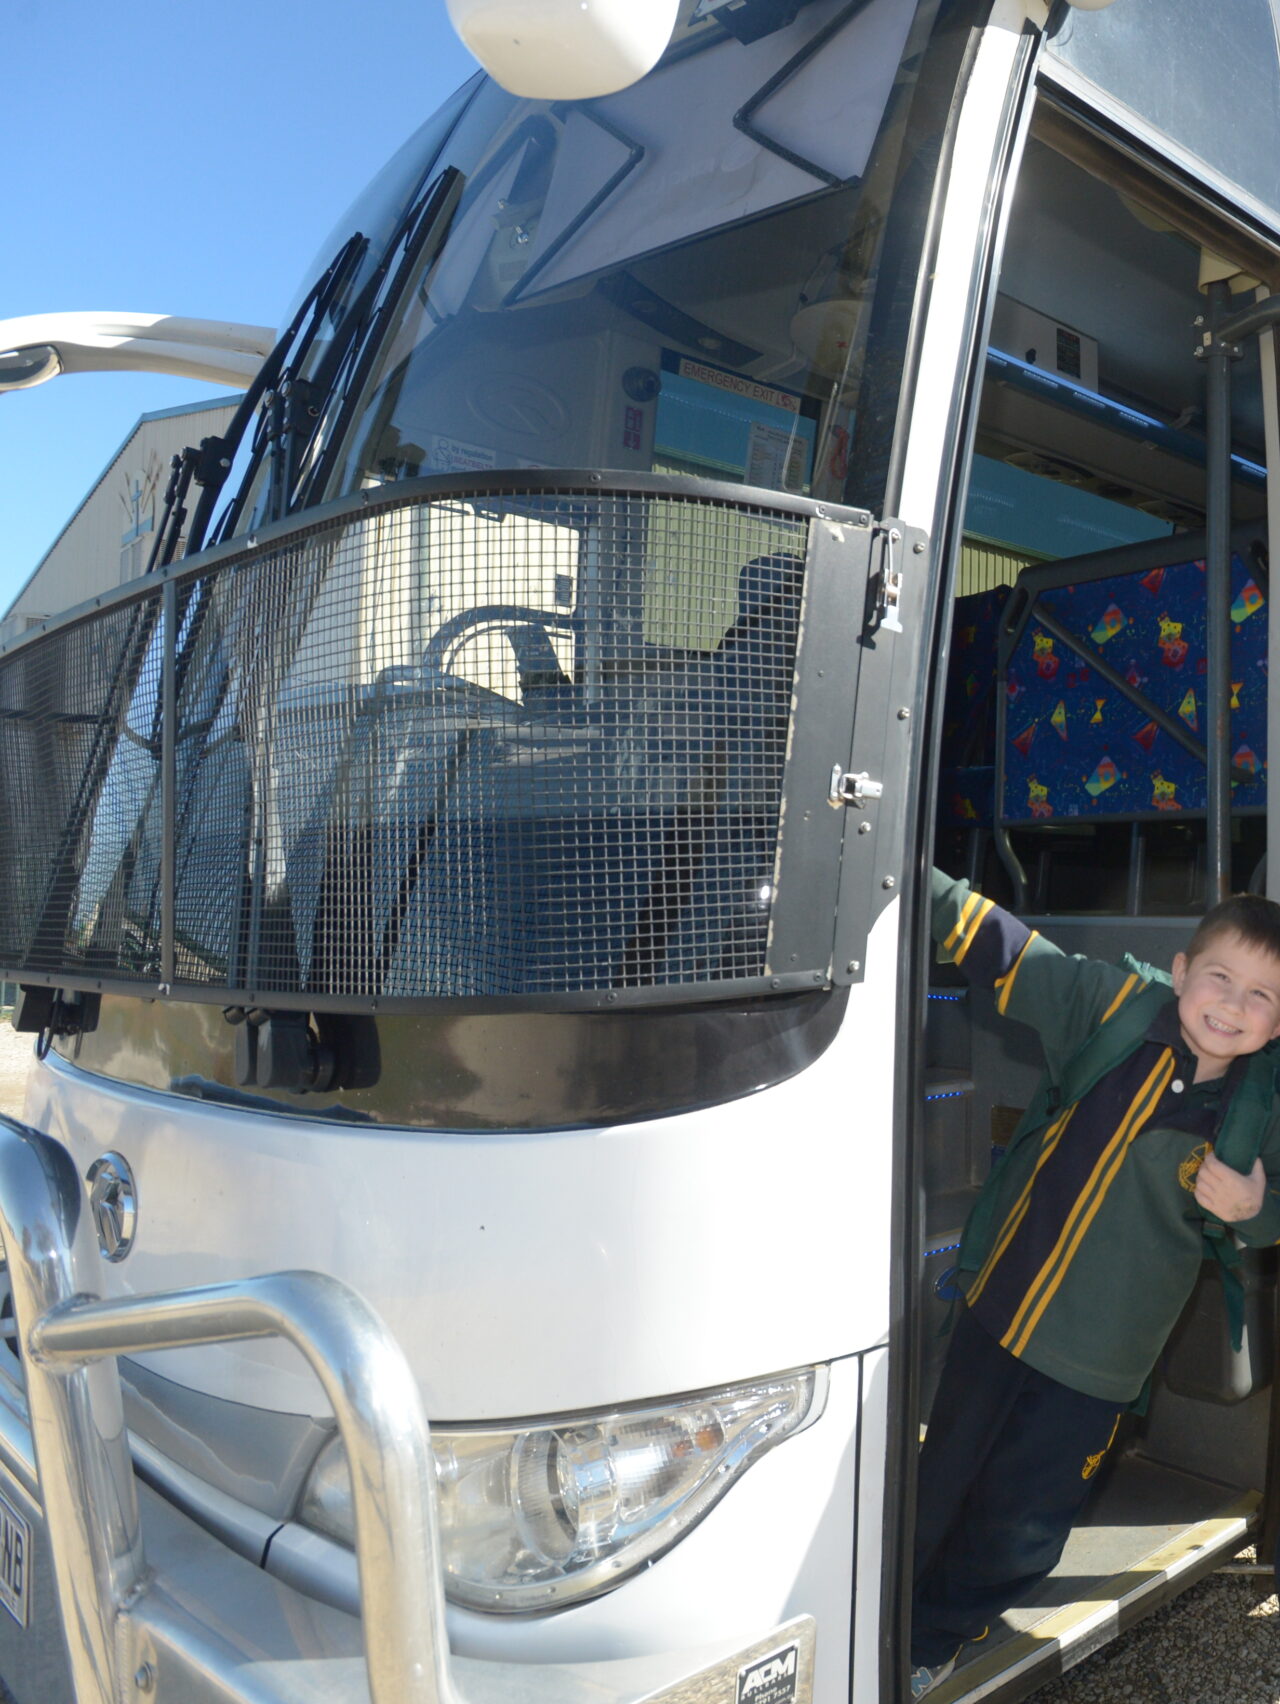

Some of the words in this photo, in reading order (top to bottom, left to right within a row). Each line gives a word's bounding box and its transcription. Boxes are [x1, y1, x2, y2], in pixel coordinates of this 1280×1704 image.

[683, 361, 753, 393] EMERGENCY
[753, 384, 775, 402] EXIT
[741, 1650, 796, 1696] ACM
